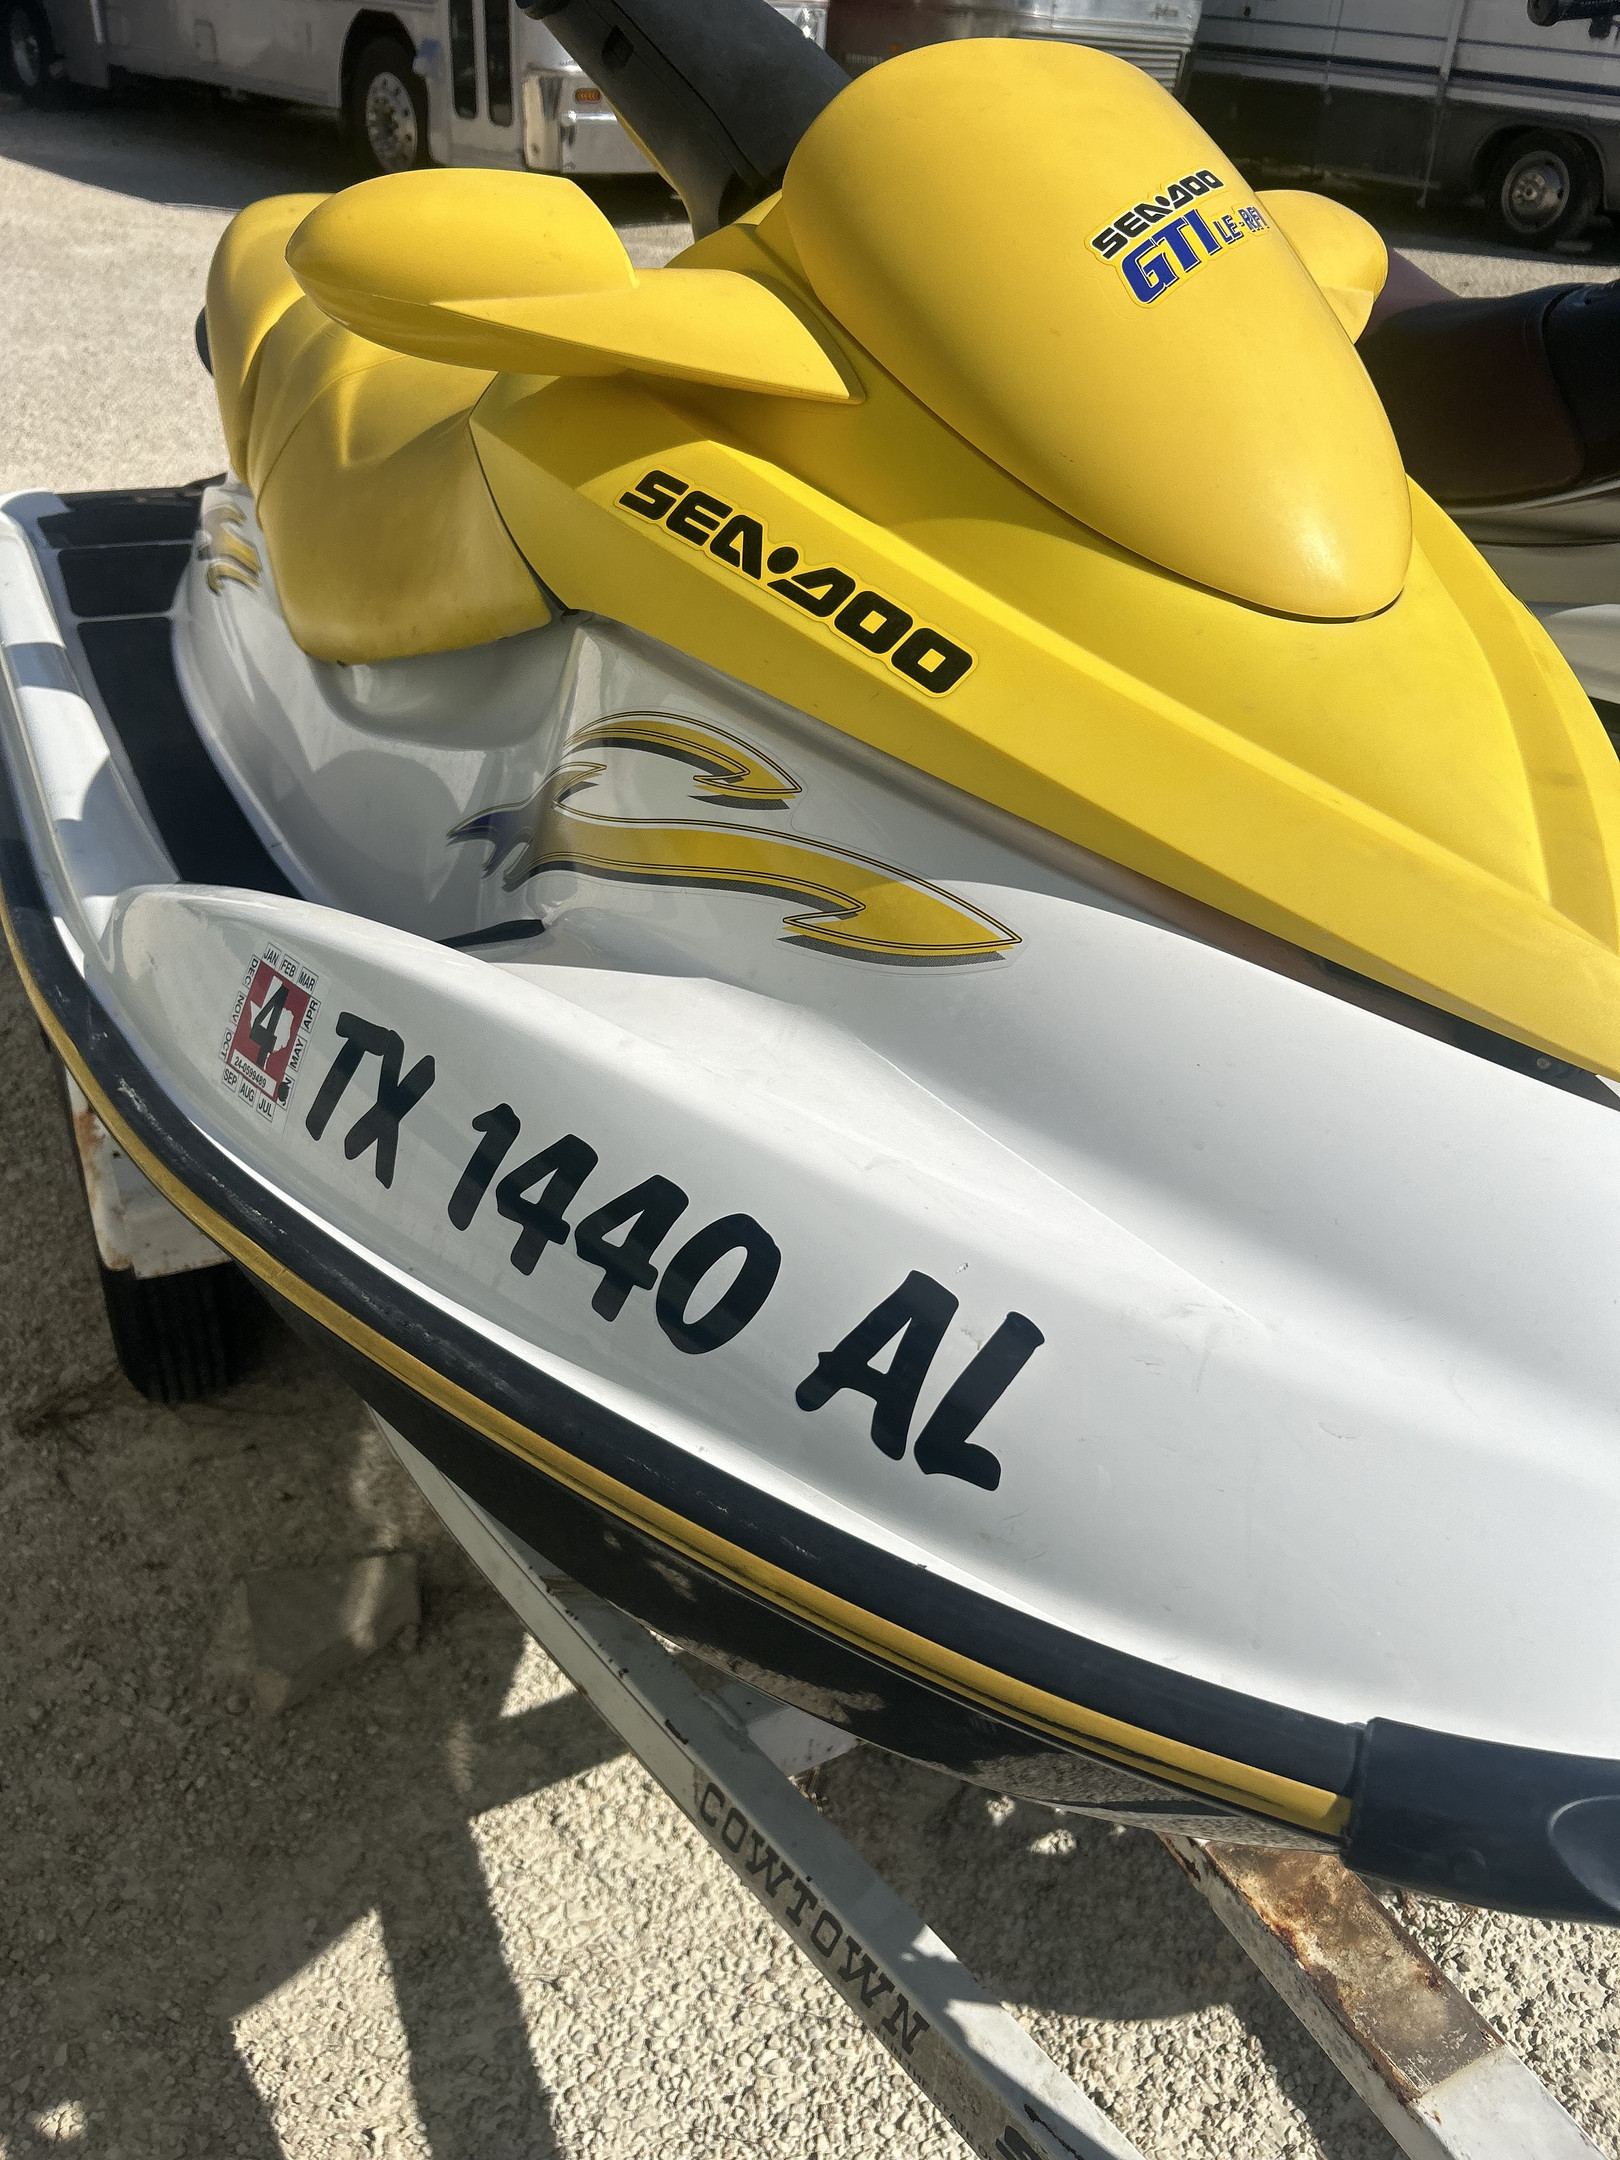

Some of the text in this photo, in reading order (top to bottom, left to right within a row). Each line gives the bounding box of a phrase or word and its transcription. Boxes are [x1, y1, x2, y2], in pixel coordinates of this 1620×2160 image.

[1122, 209, 1222, 304] GTI
[244, 958, 258, 986] DEC
[263, 948, 315, 992] JAN FEB MAR
[232, 994, 245, 1024] NOV
[250, 986, 289, 1071] 4
[303, 1000, 318, 1030] APR
[220, 1031, 232, 1062] OCT
[290, 1038, 304, 1069] MAY
[223, 1068, 273, 1118] SEP AUG JUL
[305, 1011, 1046, 1492] TX 1440 AL
[700, 1782, 930, 2056] COWTOWN
